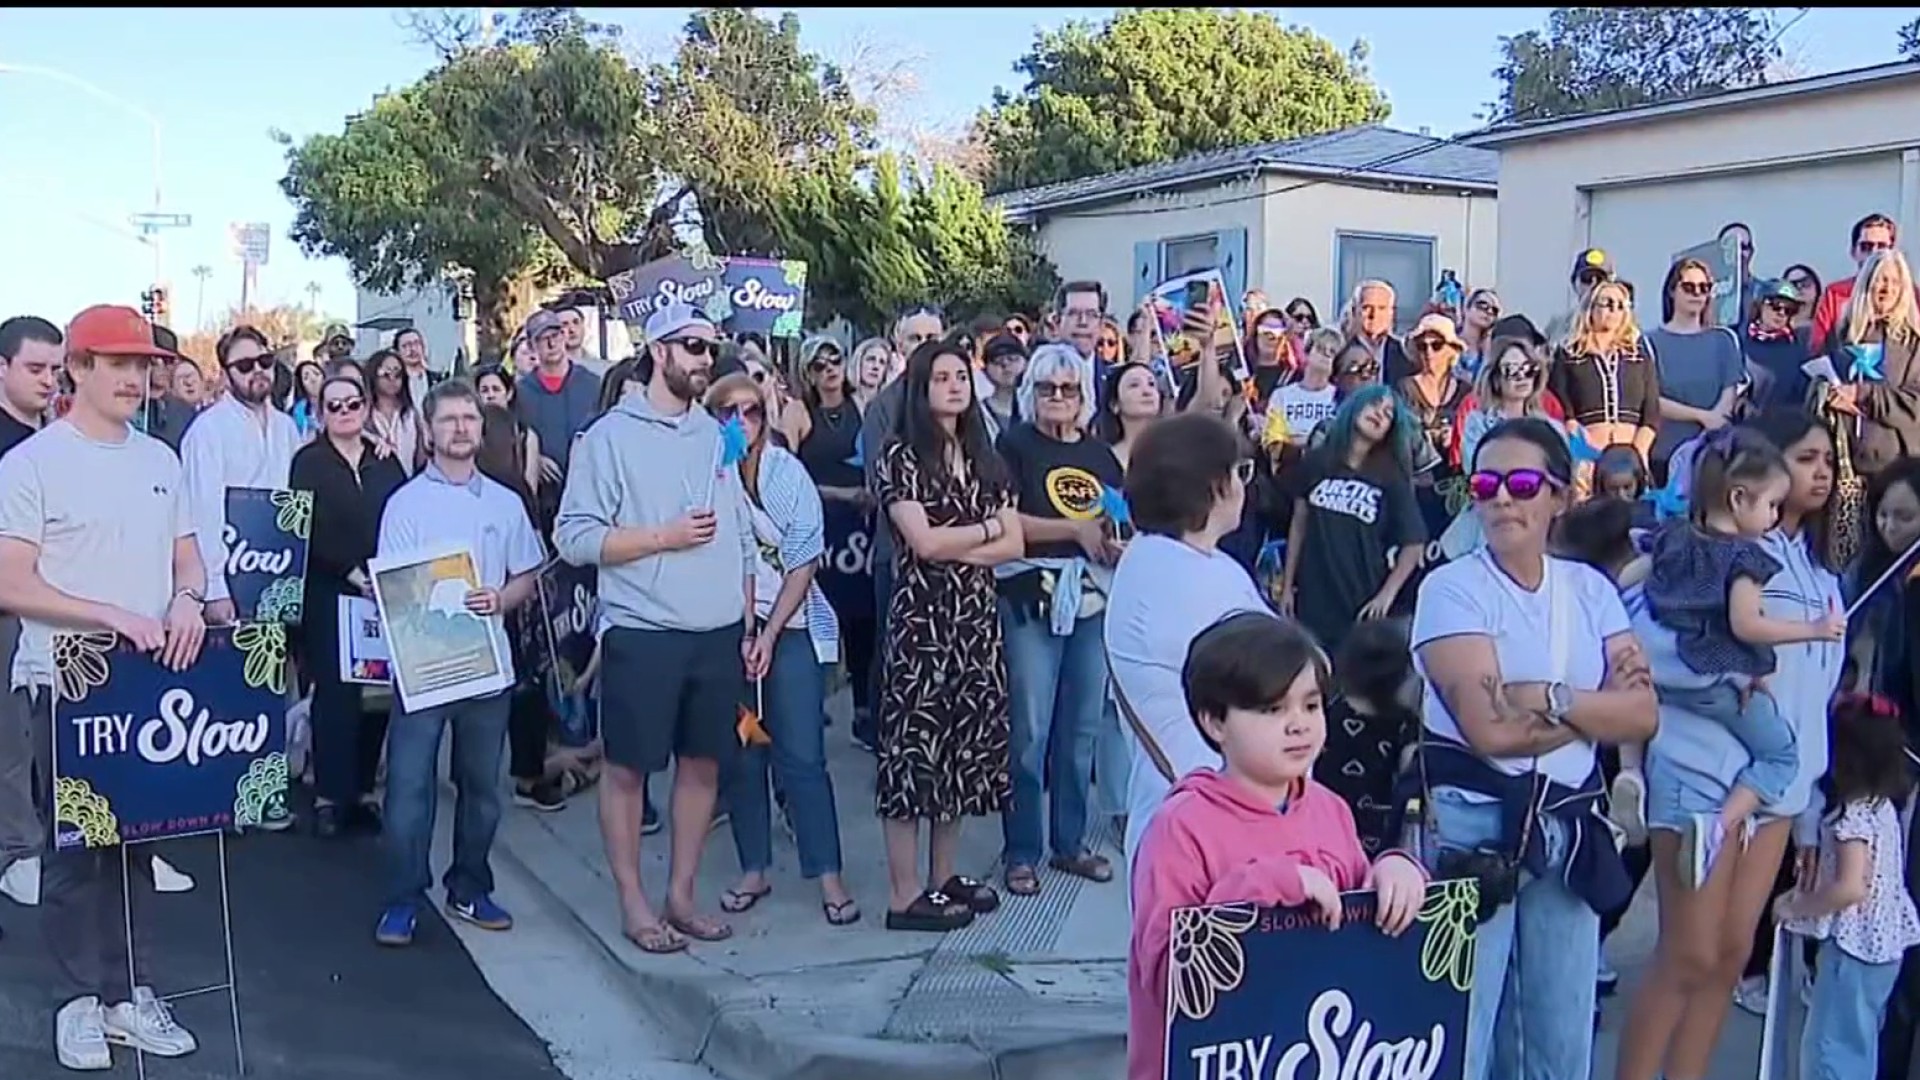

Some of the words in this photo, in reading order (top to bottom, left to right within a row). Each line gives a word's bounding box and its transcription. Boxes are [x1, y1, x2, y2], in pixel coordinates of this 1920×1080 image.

[624, 296, 655, 319] TRY
[654, 277, 714, 310] Slow
[733, 278, 796, 311] Slow
[1313, 478, 1383, 505] ARCTIC
[72, 713, 134, 757] TRY
[137, 688, 269, 766] Slow
[122, 821, 162, 837] SLOW
[166, 815, 209, 832] DOWN
[1191, 1034, 1274, 1080] TRY
[1274, 989, 1446, 1080] Slow
